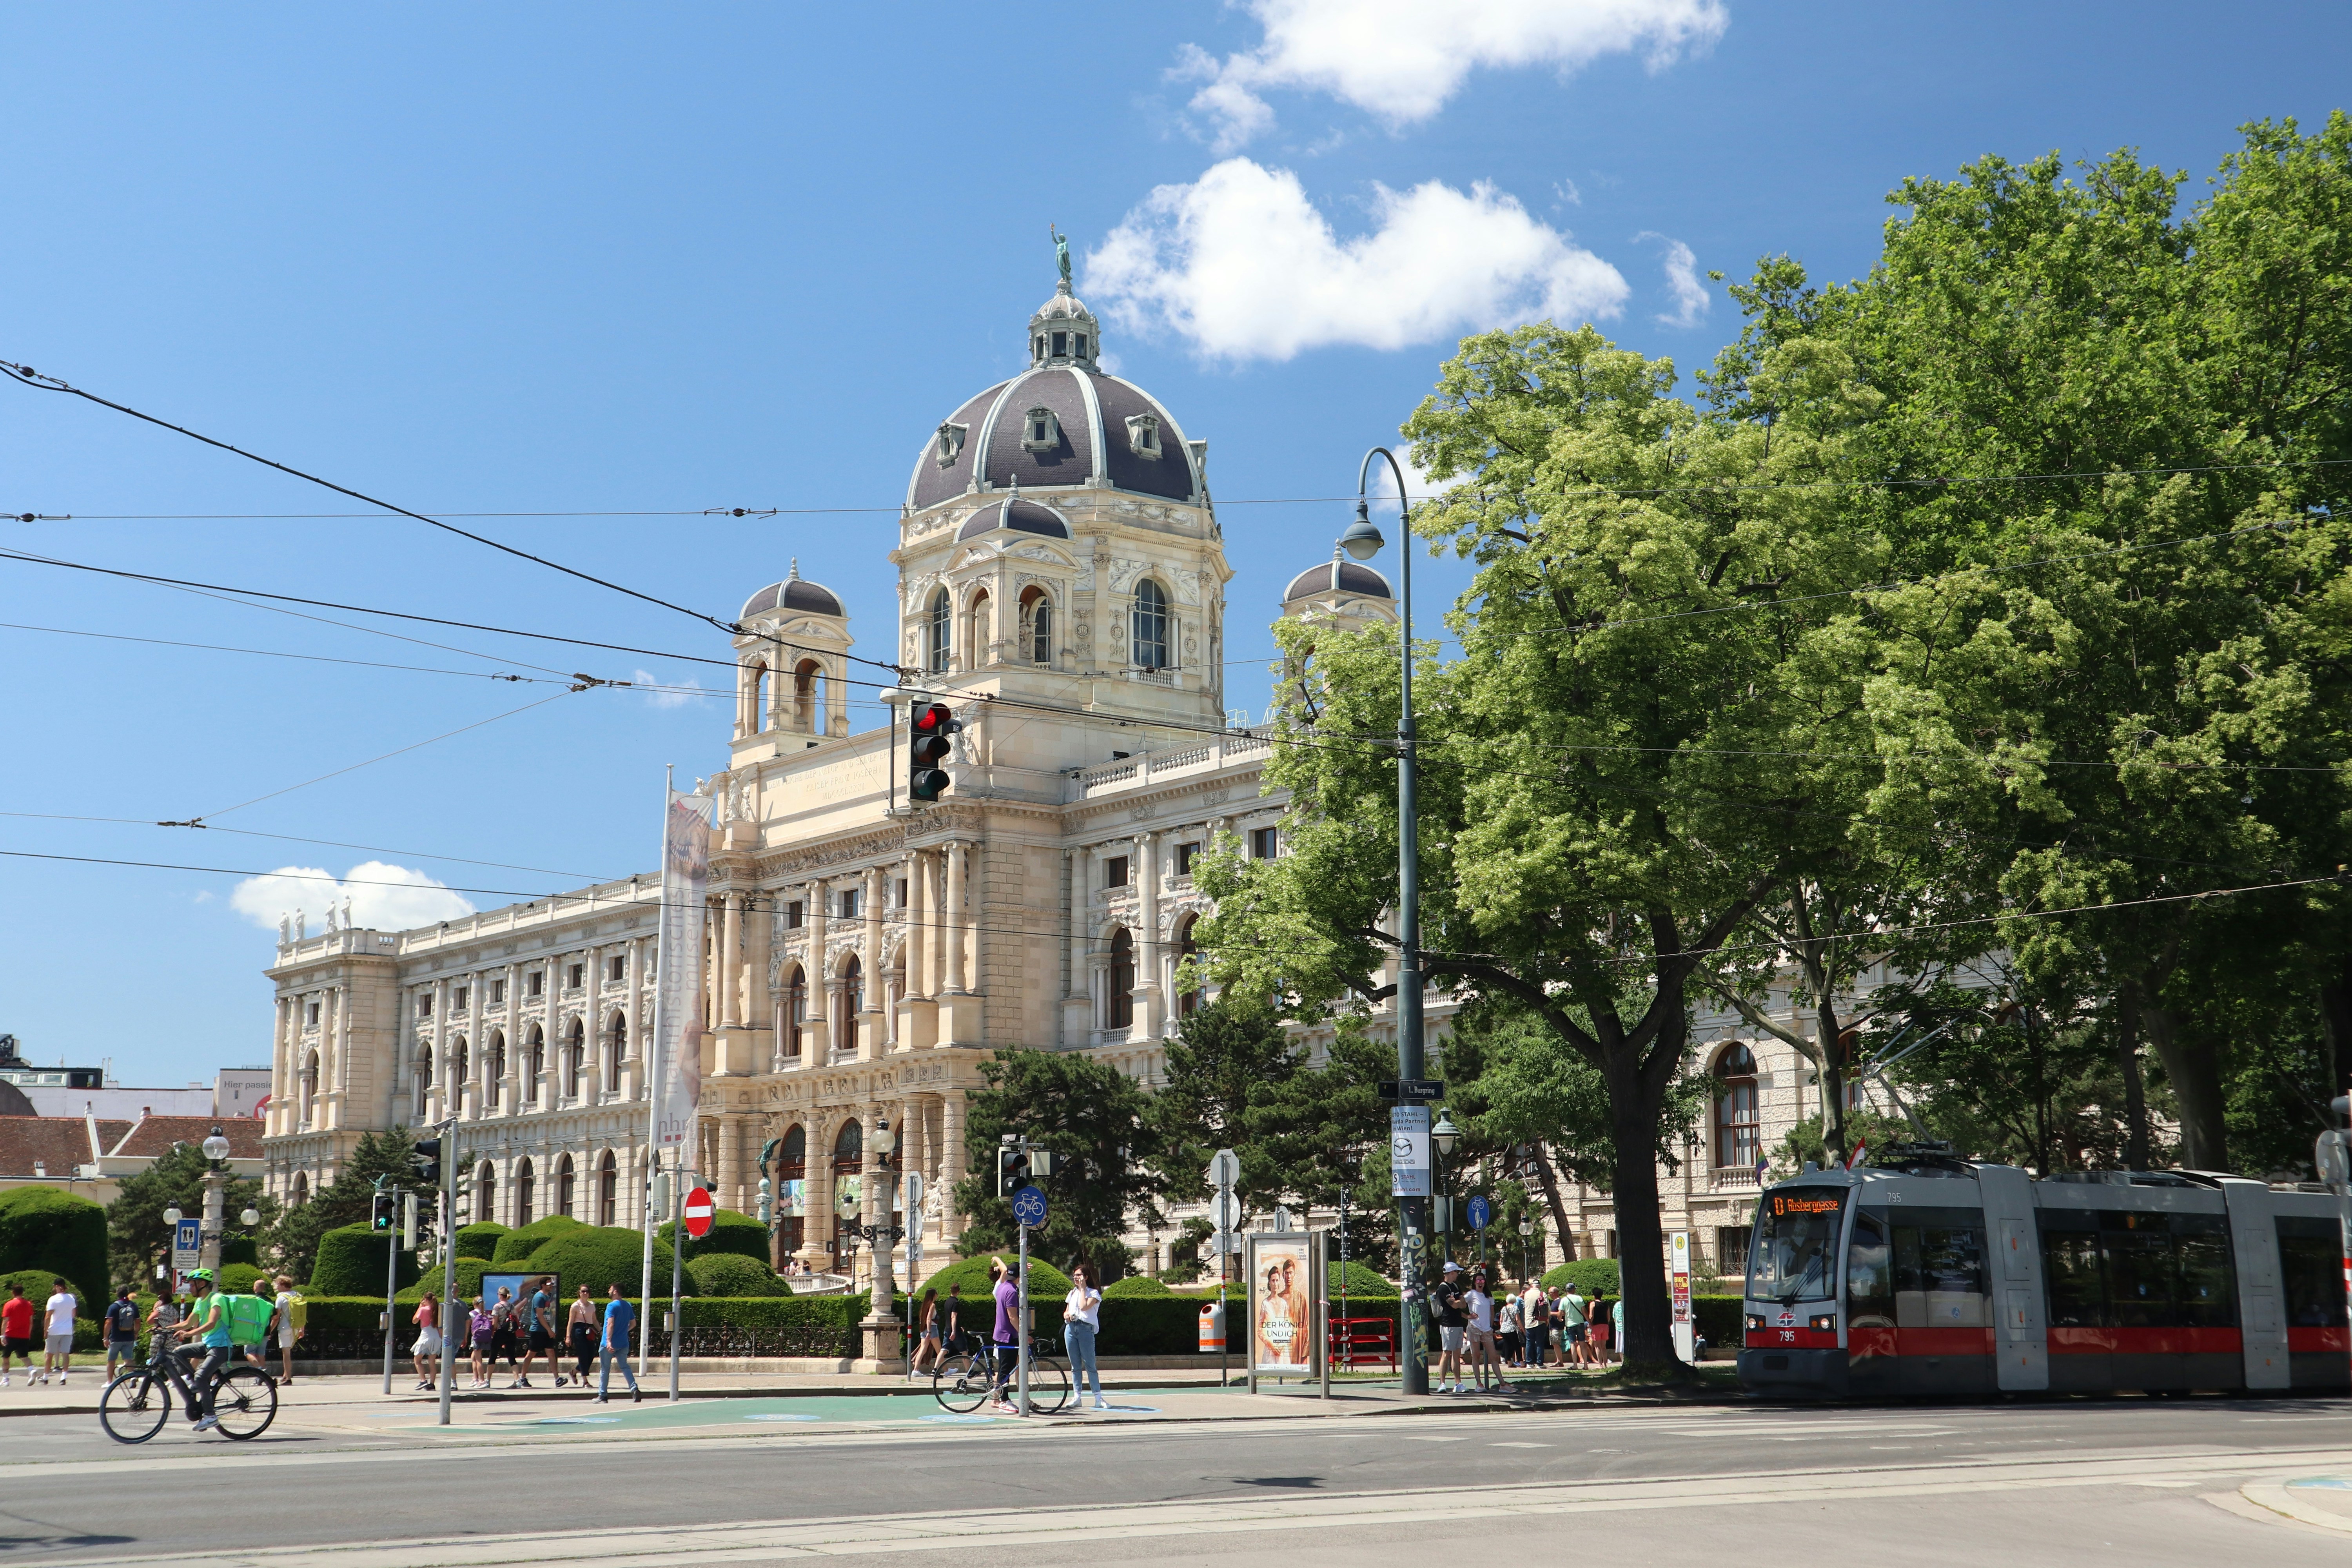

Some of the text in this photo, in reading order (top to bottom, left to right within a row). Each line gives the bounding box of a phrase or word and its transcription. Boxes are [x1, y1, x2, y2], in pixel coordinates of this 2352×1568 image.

[768, 780, 780, 789] DEM
[782, 774, 802, 786] REICHE
[805, 771, 817, 780] DER
[819, 764, 838, 777] NATUR
[841, 760, 854, 769] UND
[856, 753, 878, 765] SEINER
[806, 780, 828, 792] KAISER
[831, 774, 849, 785] FRANZ
[685, 891, 699, 991] museum
[662, 889, 684, 1094] naturhistorisches
[245, 1081, 272, 1090] passie
[1414, 1086, 1435, 1095] Burgring
[1394, 1174, 1397, 1183] S
[1887, 1192, 1901, 1203] 795
[1774, 1197, 1838, 1215] D Absberggasse
[1677, 1238, 1682, 1247] H
[1278, 1319, 1303, 1328] KÖNIG
[1779, 1331, 1795, 1342] 795
